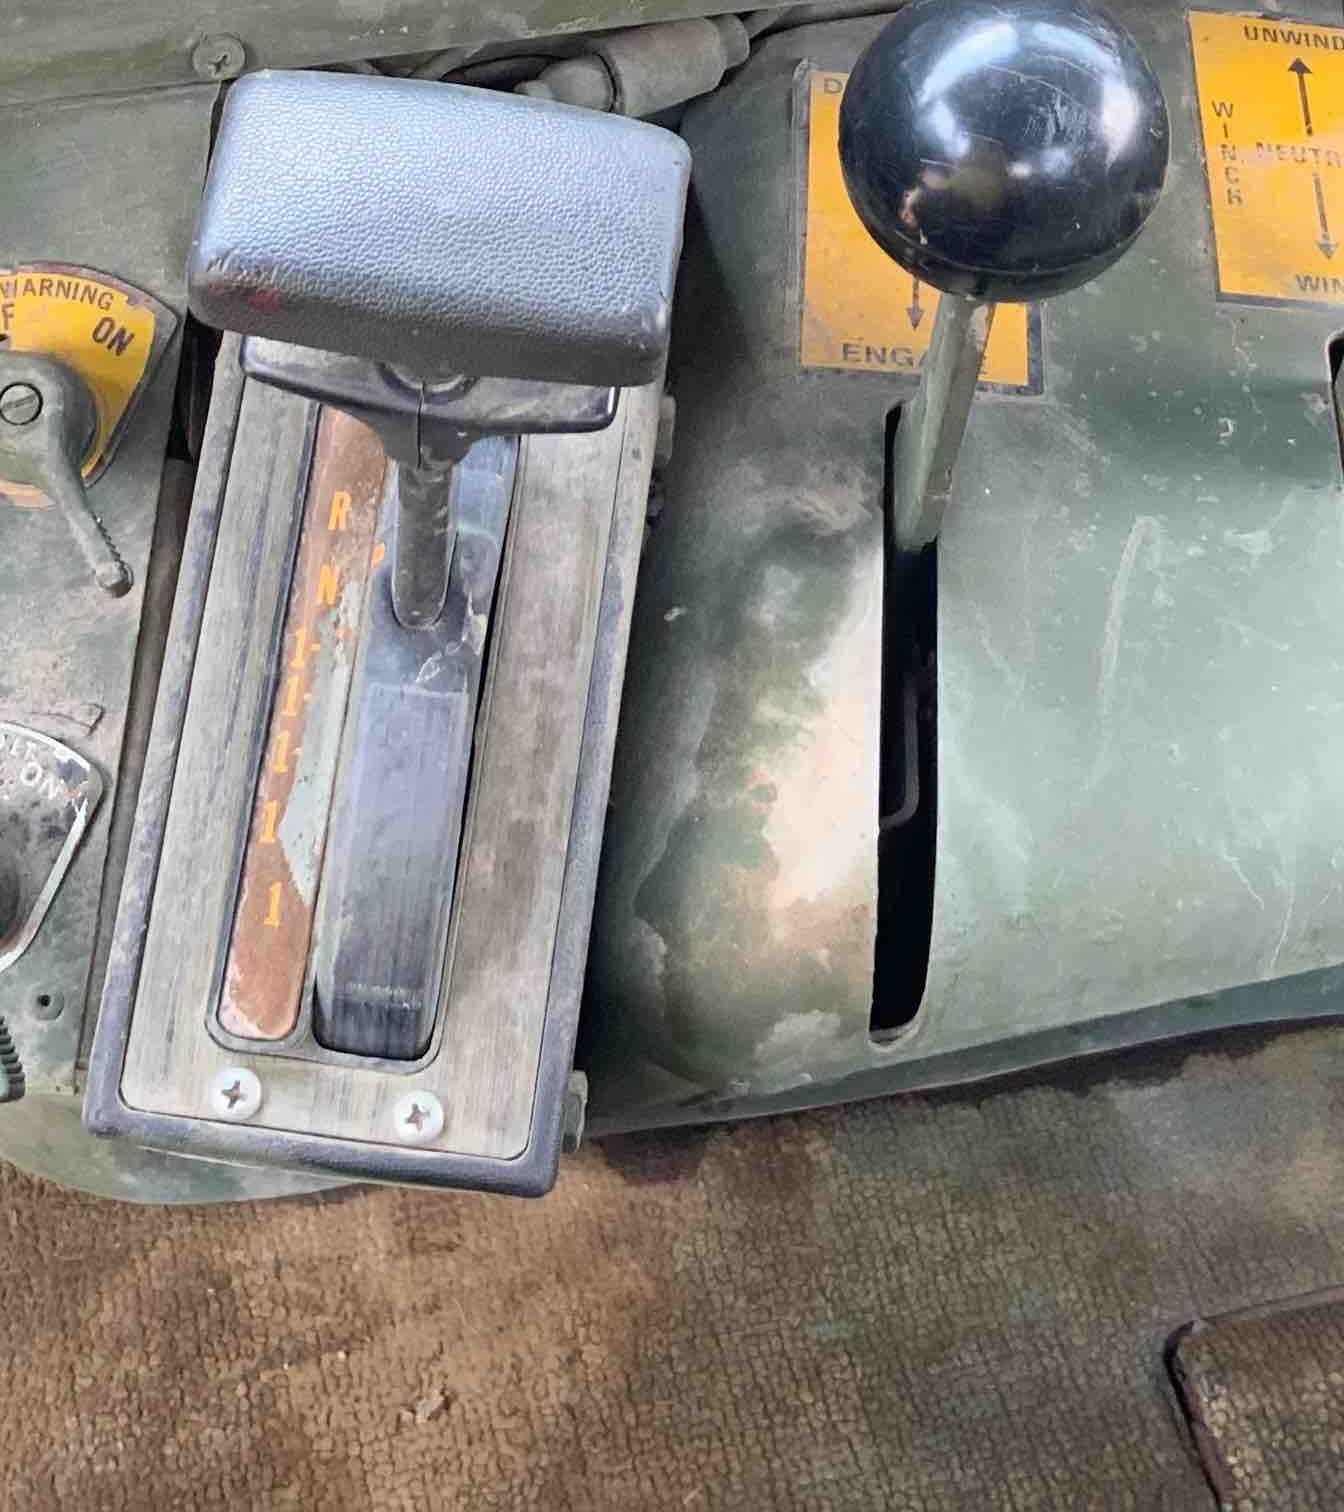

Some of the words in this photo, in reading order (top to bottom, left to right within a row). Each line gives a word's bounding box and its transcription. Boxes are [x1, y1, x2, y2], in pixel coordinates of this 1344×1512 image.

[0, 279, 115, 312] WARNING
[91, 317, 135, 356] ON
[328, 491, 352, 531] R
[319, 562, 338, 606] N
